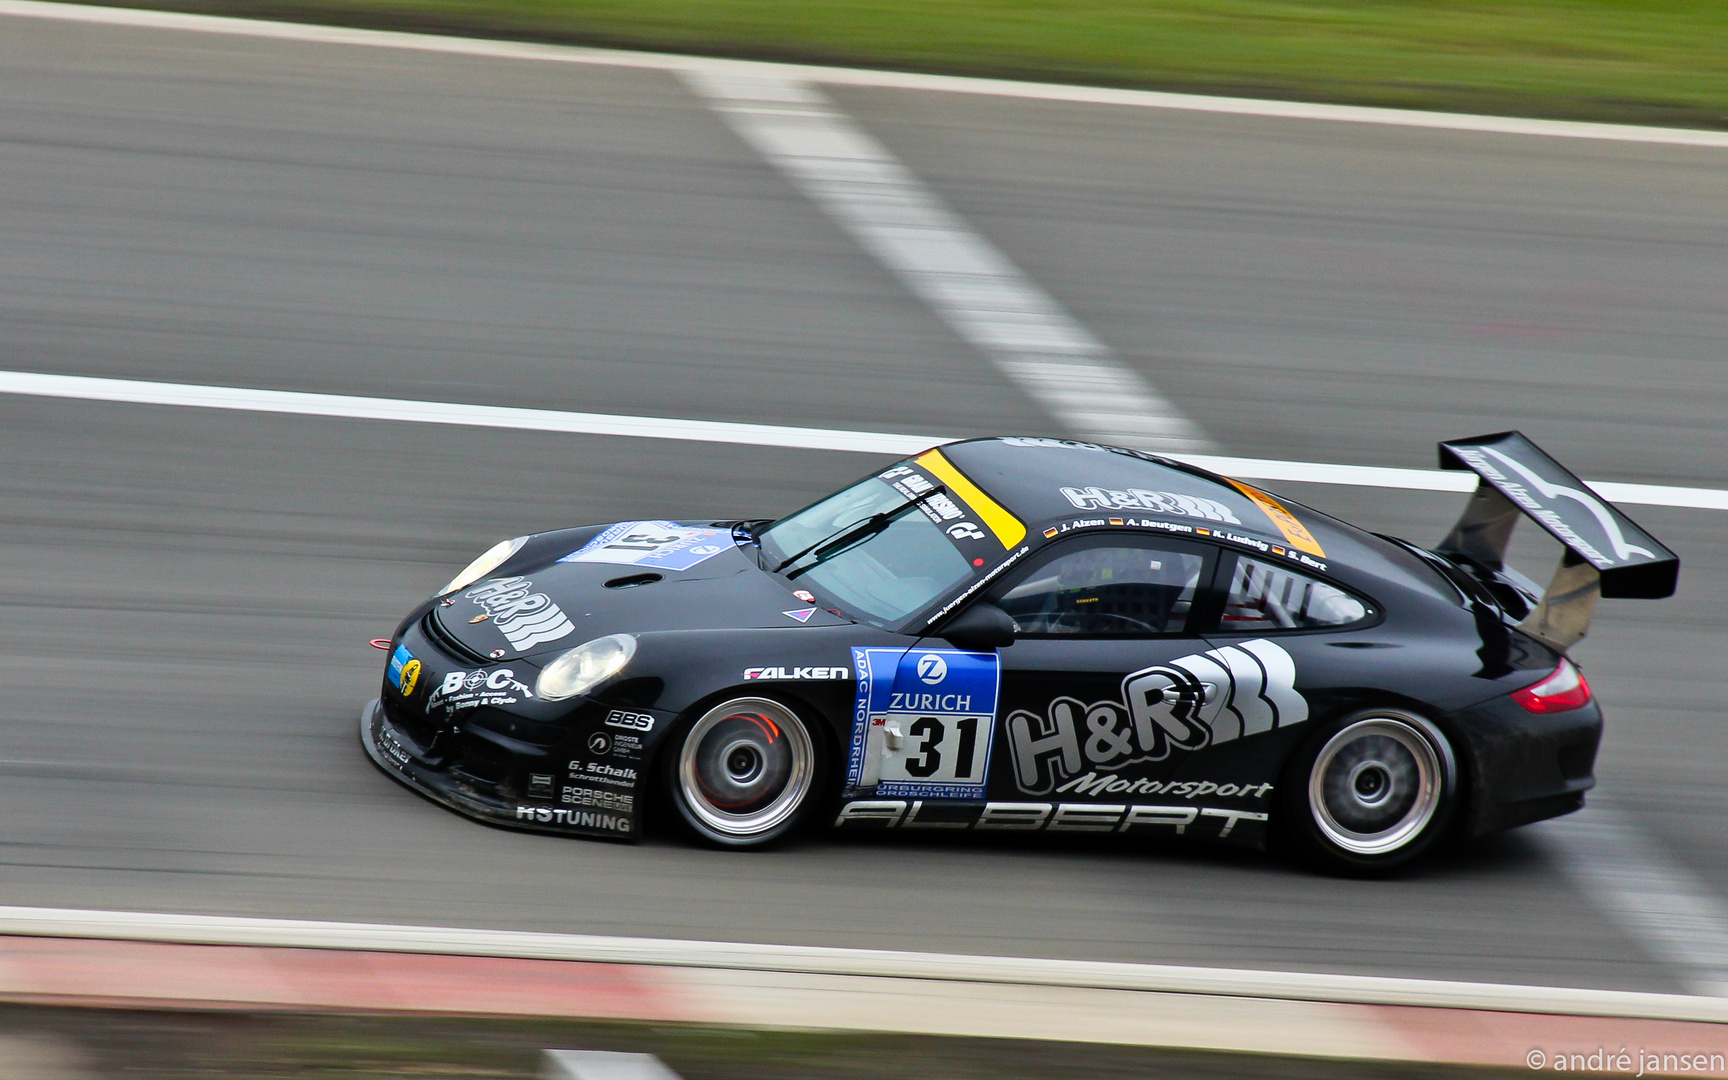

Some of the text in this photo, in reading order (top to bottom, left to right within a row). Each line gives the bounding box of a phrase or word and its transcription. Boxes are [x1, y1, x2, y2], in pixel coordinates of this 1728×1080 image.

[1060, 518, 1105, 533] J. Alzen
[1126, 518, 1193, 533] A. Deutgen
[1212, 530, 1269, 552] K. Ludwig
[1534, 508, 1615, 566] Motorsport
[1287, 550, 1328, 571] S. Bert
[743, 666, 849, 680] FALKEN
[854, 650, 869, 693] ADAC
[889, 693, 971, 712] ZURICH
[604, 709, 656, 732] BBS
[872, 718, 887, 727] 3M
[1005, 665, 1211, 796] H&R
[905, 716, 980, 779] 31
[568, 760, 638, 780] G. Schalk
[562, 786, 635, 805] PORSCHE
[1056, 771, 1274, 799] Motorsport
[561, 794, 613, 810] SCENE
[833, 800, 1269, 838] ALBERT
